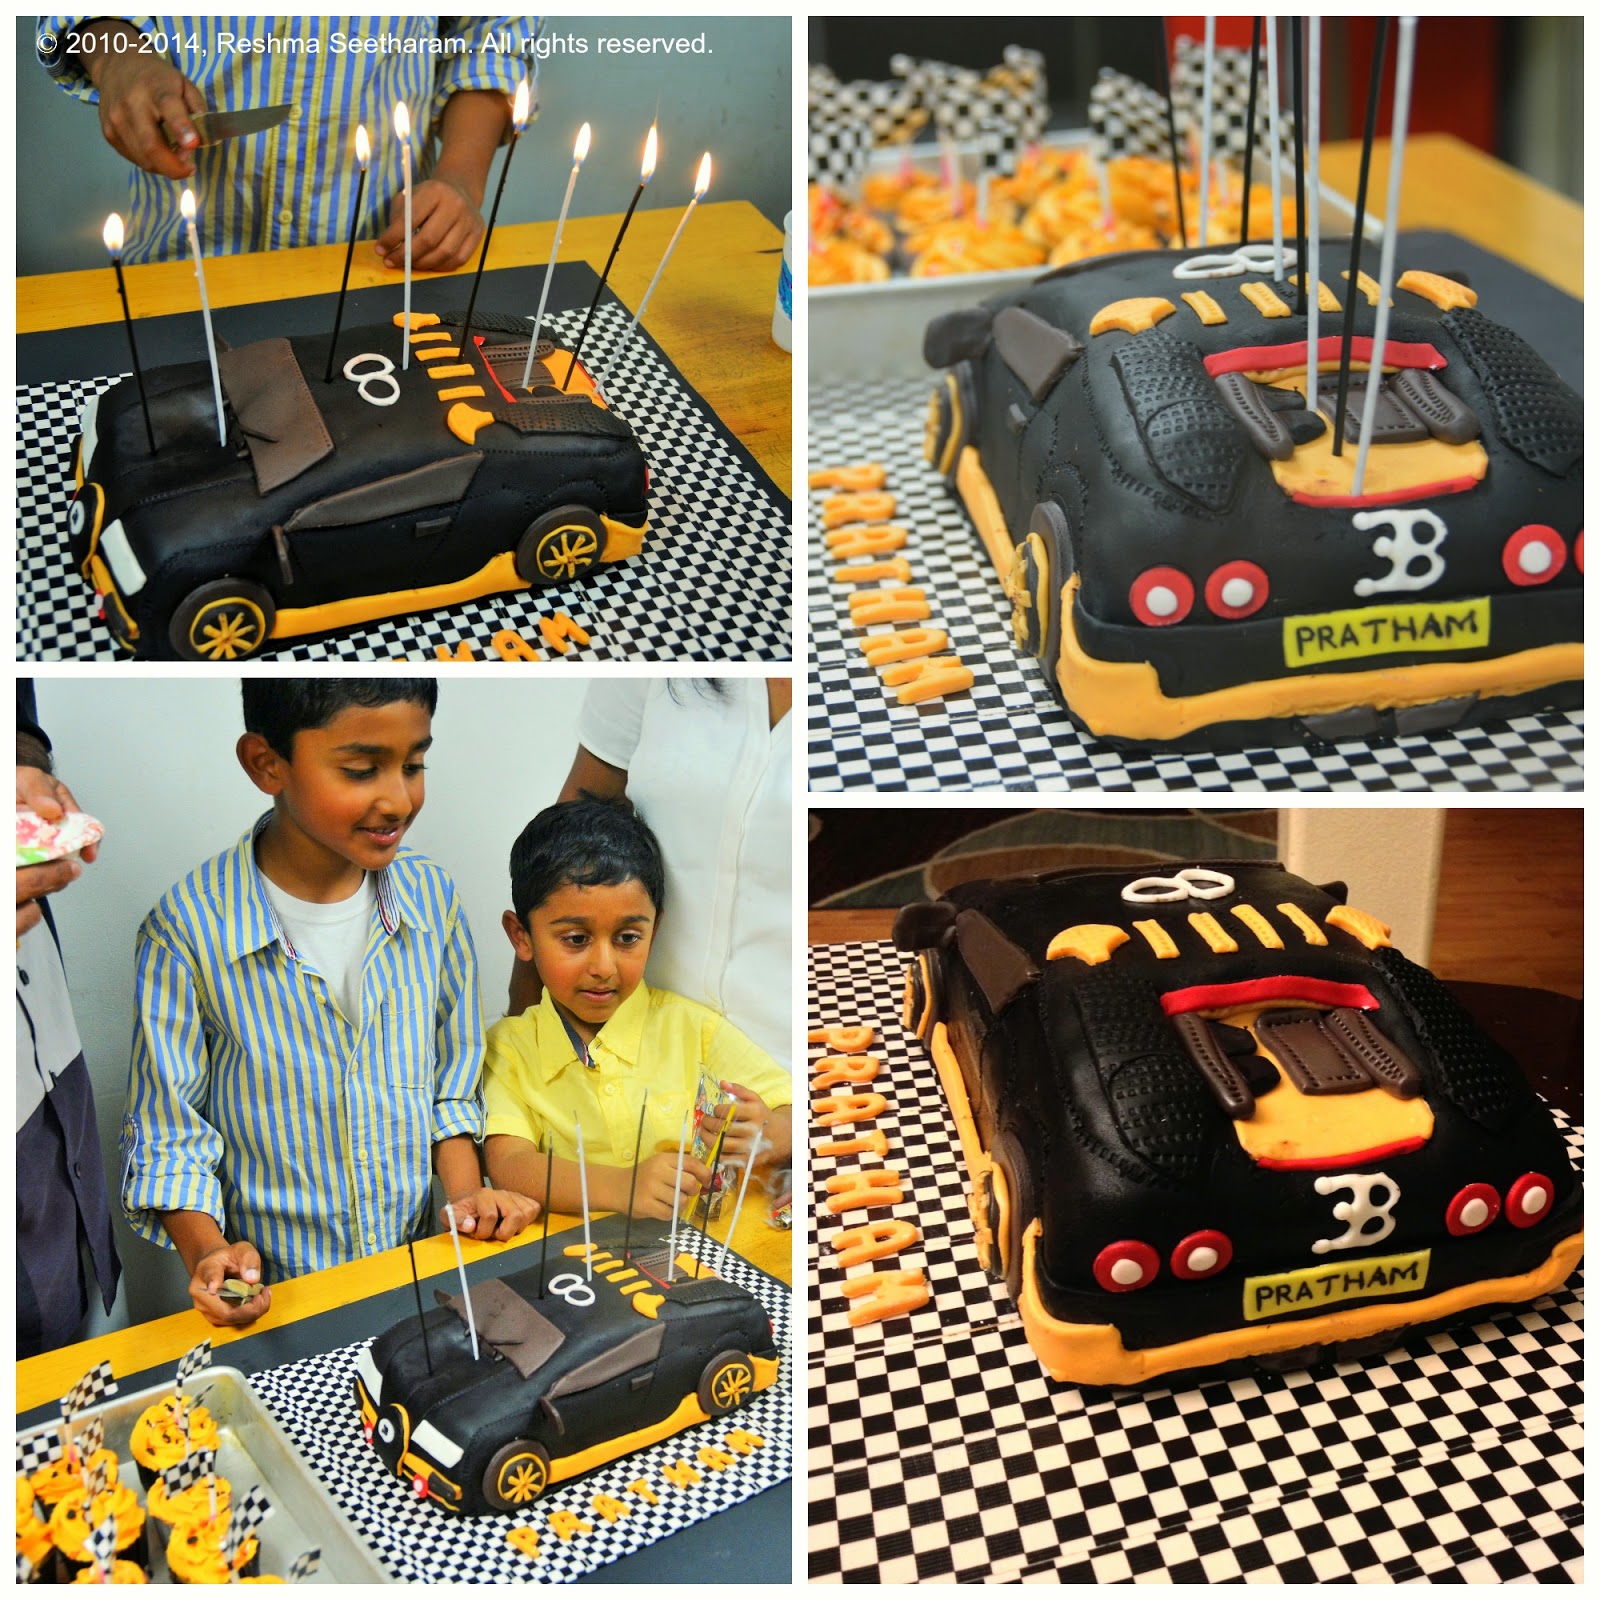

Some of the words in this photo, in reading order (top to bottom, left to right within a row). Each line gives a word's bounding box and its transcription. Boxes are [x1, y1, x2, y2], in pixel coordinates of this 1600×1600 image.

[343, 353, 400, 407] 8
[1295, 609, 1478, 656] PRATHAM
[548, 1273, 596, 1307] 8
[1256, 1262, 1419, 1311] PRATHAM
[506, 1428, 765, 1560] PRATHAM
